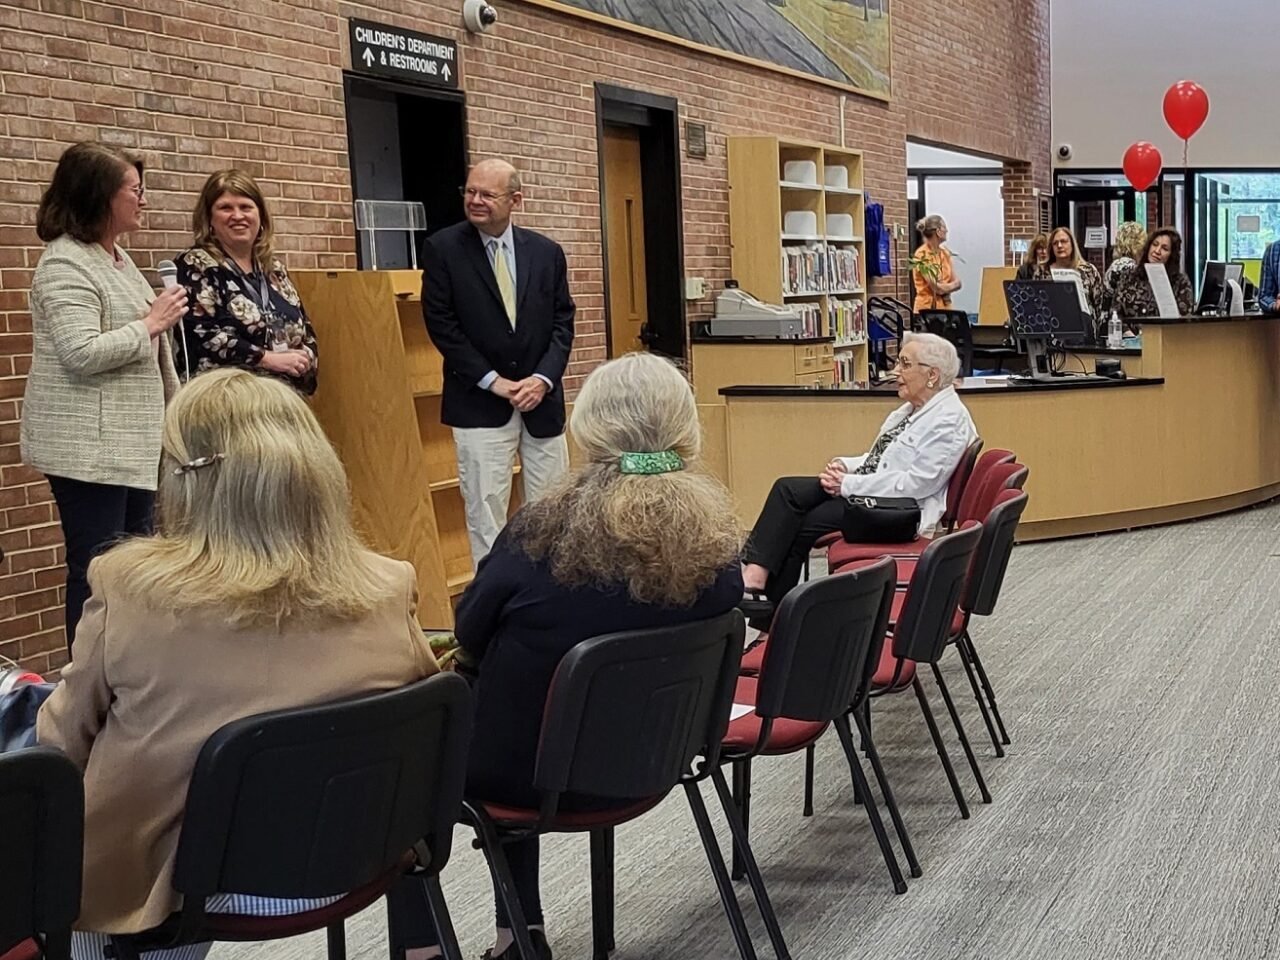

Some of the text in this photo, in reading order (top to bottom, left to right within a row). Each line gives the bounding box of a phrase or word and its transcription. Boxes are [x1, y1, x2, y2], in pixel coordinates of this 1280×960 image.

[355, 26, 455, 60] CHILDREN'S DEPARTMENT
[380, 50, 437, 75] & RESTROOMS
